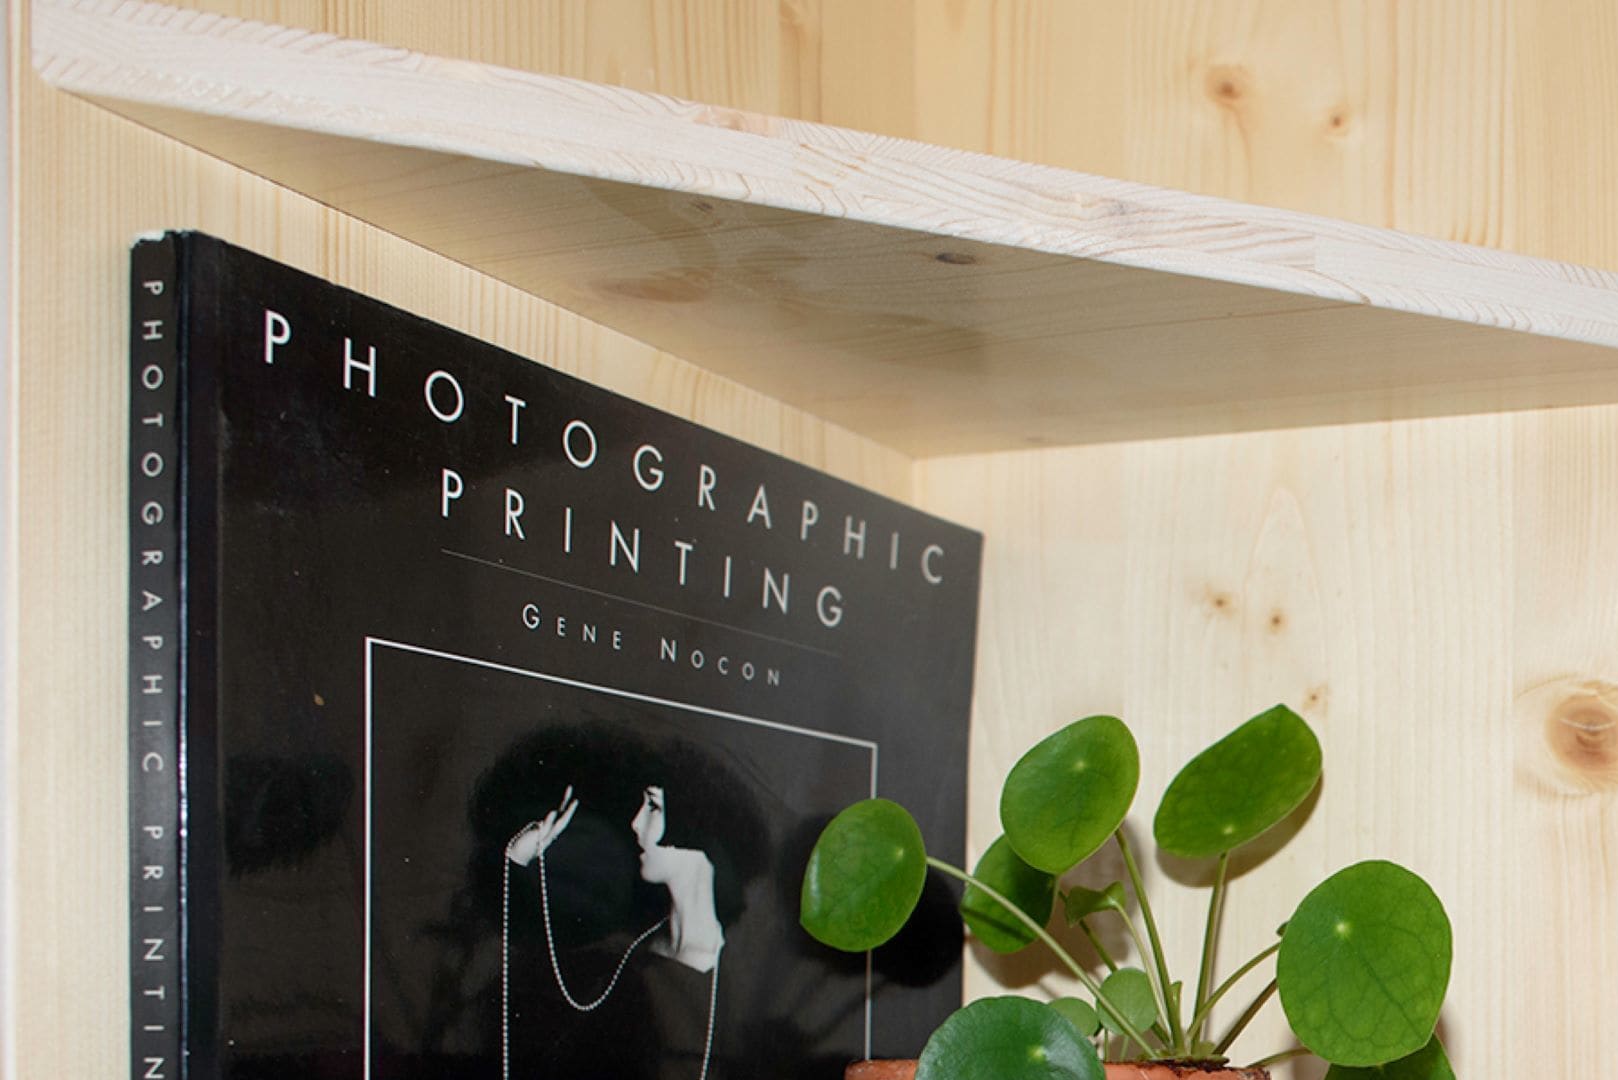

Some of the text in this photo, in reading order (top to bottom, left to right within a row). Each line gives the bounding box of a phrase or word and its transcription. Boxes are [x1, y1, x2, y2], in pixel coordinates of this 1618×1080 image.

[141, 280, 164, 772] PHOTOGRAPHIC
[264, 309, 945, 586] PHOTOGRAPHIC
[441, 469, 844, 628] PRINTING
[521, 603, 782, 687] GENE NOCON
